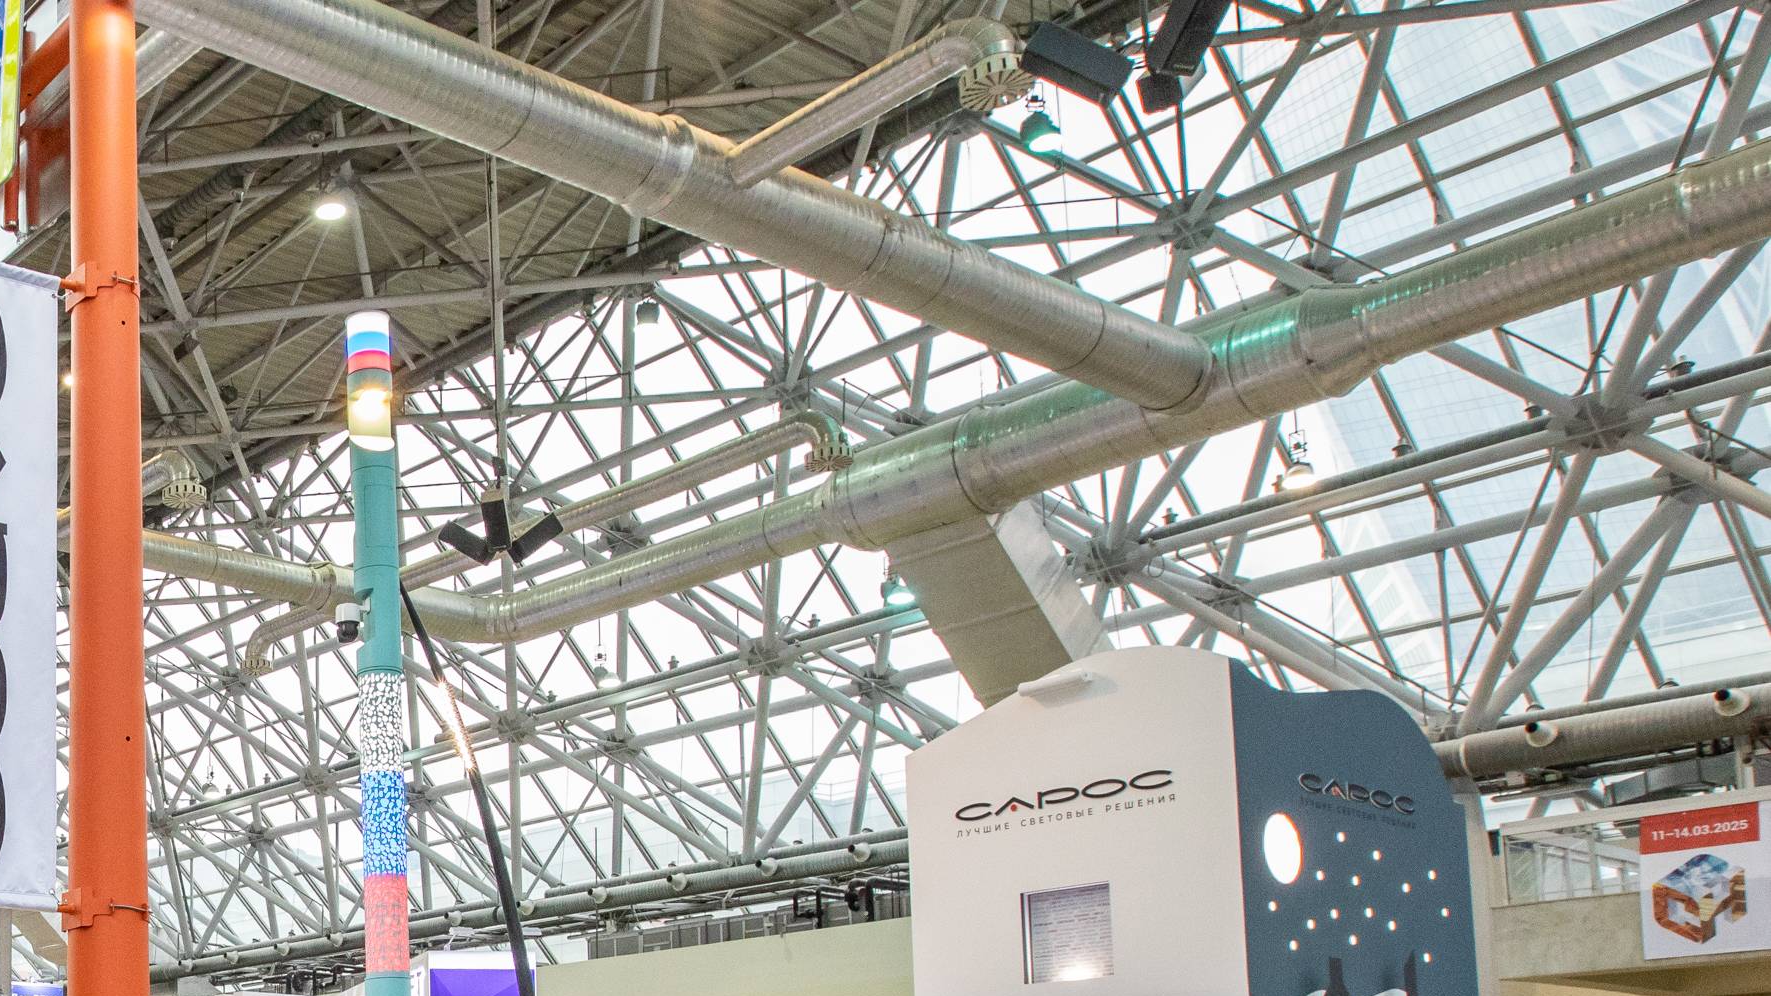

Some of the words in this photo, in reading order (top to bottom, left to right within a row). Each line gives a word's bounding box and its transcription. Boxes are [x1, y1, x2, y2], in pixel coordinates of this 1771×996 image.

[956, 822, 1011, 838] ЛУЧШИЕ
[1020, 807, 1094, 827] СВЕТОВЫЕ
[1105, 793, 1177, 812] РЕШЕНИЯ
